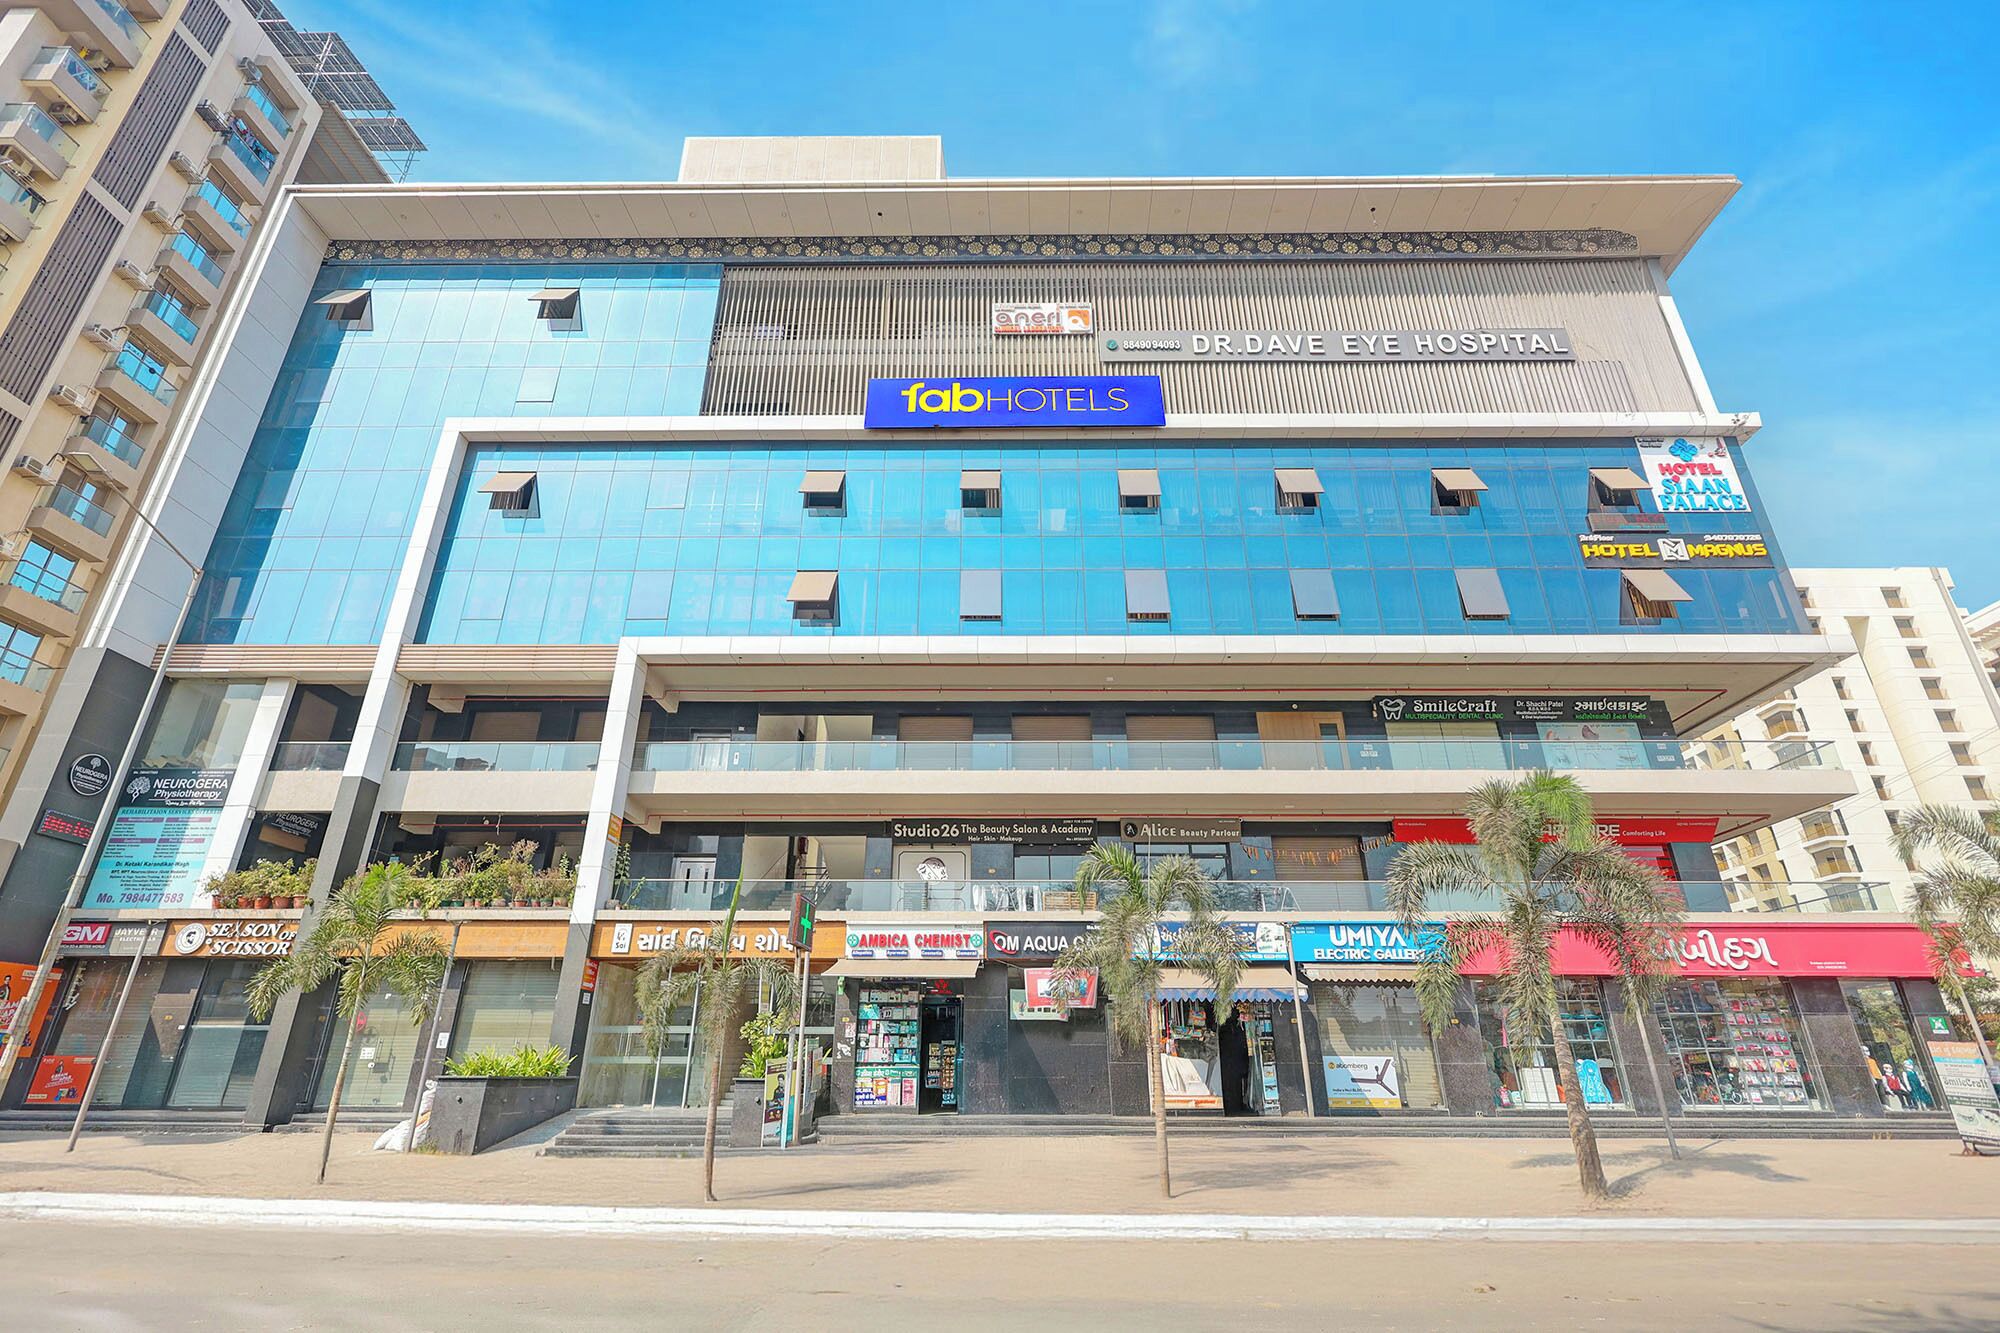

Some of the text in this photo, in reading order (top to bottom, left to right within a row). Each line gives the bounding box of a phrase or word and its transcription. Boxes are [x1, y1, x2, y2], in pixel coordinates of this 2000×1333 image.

[1342, 334, 1402, 355] EYE
[1416, 333, 1569, 354] HOSPITAL
[901, 382, 1130, 413] fabHOTELS
[1658, 462, 1723, 475] HOTEL
[1658, 494, 1748, 510] PALACE
[1581, 543, 1660, 558] HOTEL
[1687, 543, 1768, 558] MAGNUS
[1413, 699, 1497, 712] SmileCraft
[75, 765, 108, 780] NEUROGERA
[153, 778, 228, 789] NEUROGERA
[154, 790, 222, 800] Physiotherapy
[894, 823, 1093, 837] Studio26 The Beauty Salon & Academy
[1180, 829, 1208, 838] Beauty
[1210, 829, 1240, 837] Parlour
[96, 893, 184, 904] Mo. 7984477583
[63, 926, 106, 942] GM
[115, 927, 159, 936] JAYVER
[279, 930, 298, 941] OF
[1328, 925, 1407, 947] UMIYA
[859, 933, 971, 948] AMBICA CHEMIST
[993, 935, 1019, 951] OM
[1023, 935, 1069, 952] AQUA
[210, 941, 291, 955] SCISSOR
[1314, 948, 1370, 960] ELECTRIC
